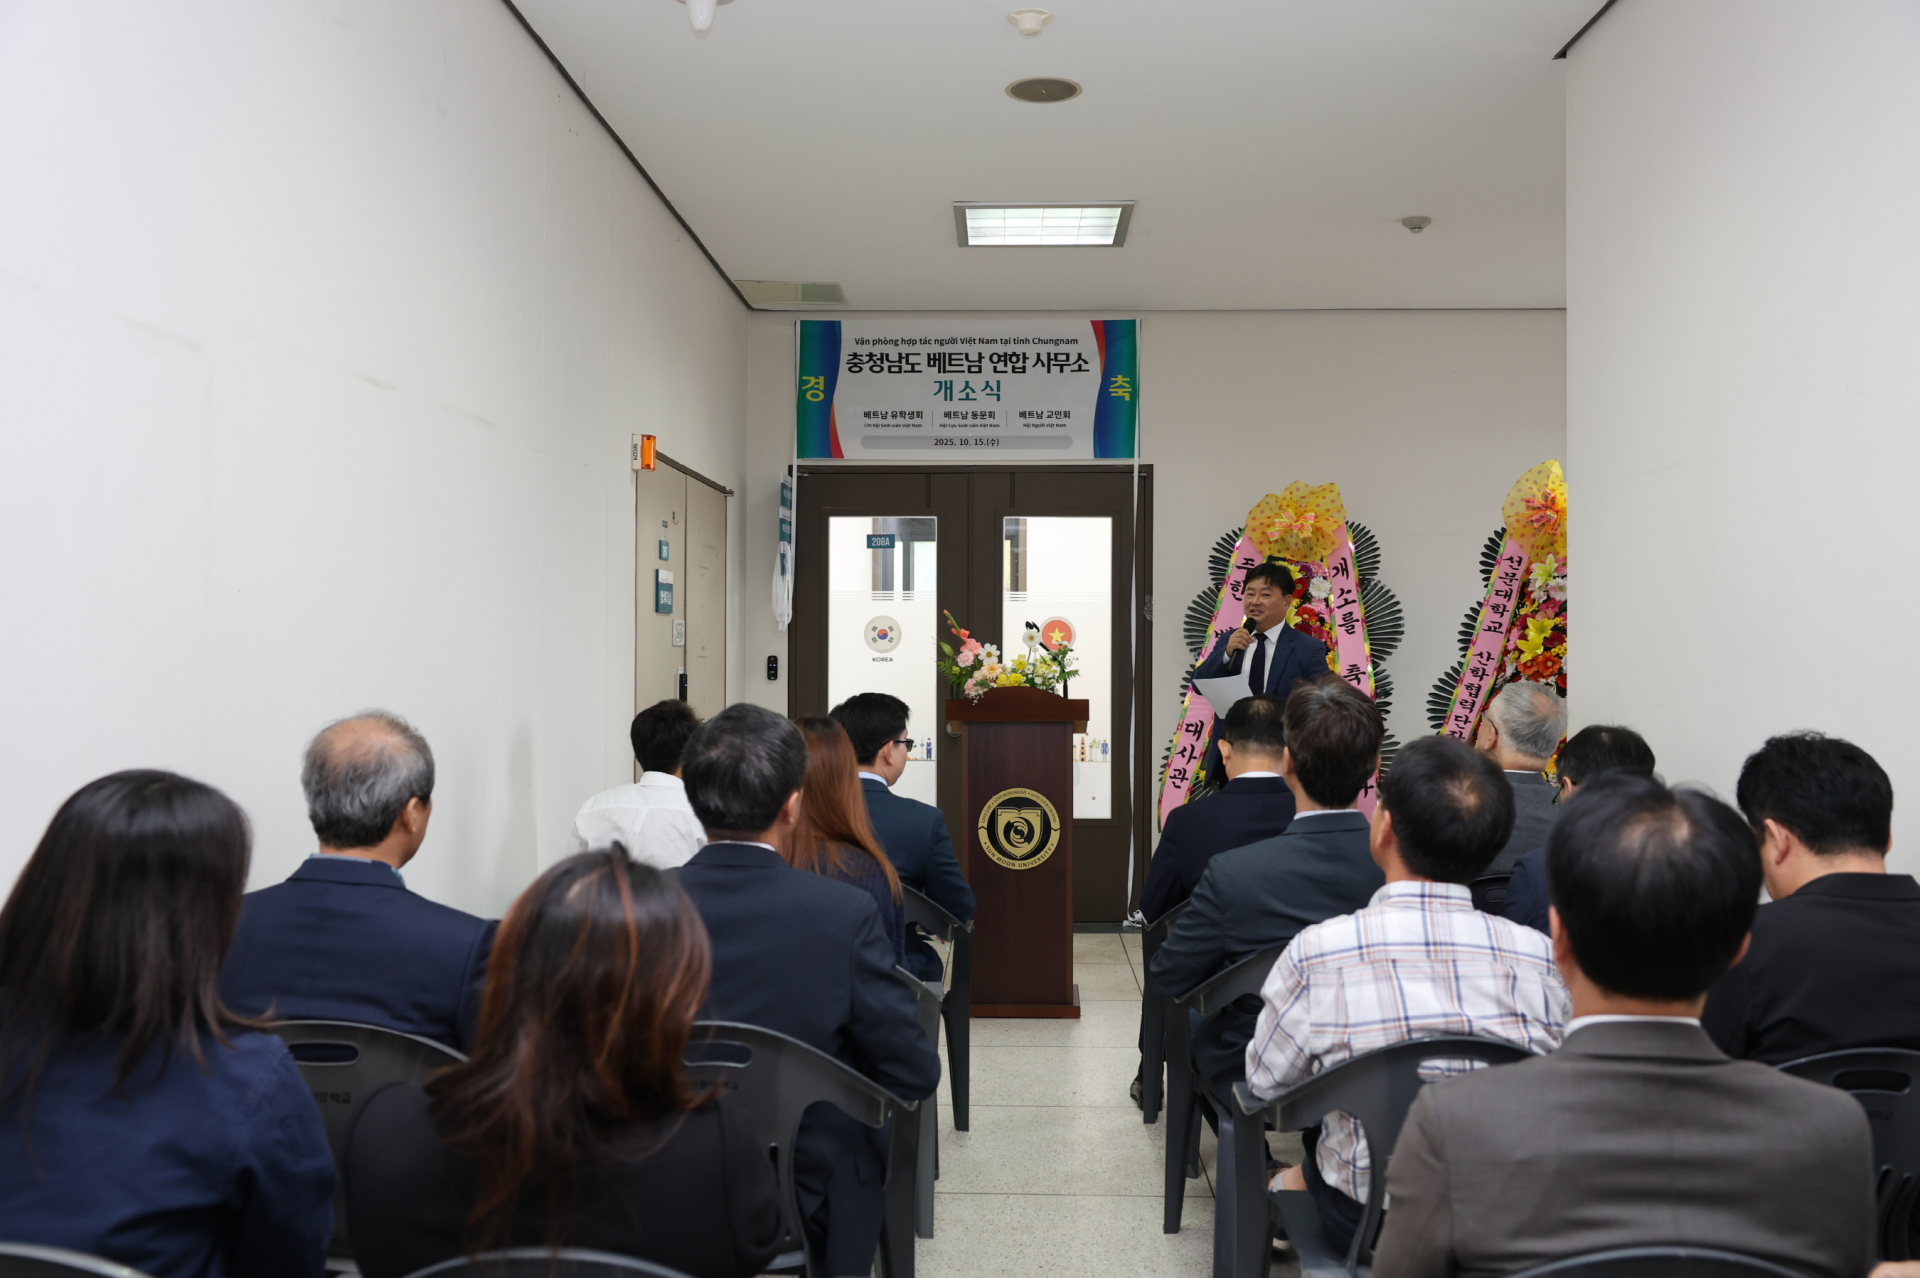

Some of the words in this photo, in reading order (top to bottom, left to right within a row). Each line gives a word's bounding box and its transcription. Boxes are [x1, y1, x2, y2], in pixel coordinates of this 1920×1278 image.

[854, 338, 870, 346] Văn
[872, 336, 900, 347] phòng
[901, 338, 918, 347] hợp
[919, 336, 932, 345] tác
[934, 336, 958, 346] người
[960, 336, 976, 346] Việt
[1000, 336, 1011, 346] tại
[1013, 336, 1030, 345] tỉnh
[1032, 337, 1078, 346] Chungnam
[846, 352, 922, 374] 충청남도
[926, 352, 985, 374] 베트남
[989, 352, 1029, 374] 연합
[1032, 352, 1090, 374] 사무소
[802, 376, 825, 401] 경
[1109, 374, 1132, 401] 축
[864, 410, 888, 420] 베트남
[890, 410, 923, 420] 유학생회
[944, 410, 968, 420] 베트남
[971, 410, 995, 420] 동문회
[1019, 410, 1044, 420] 베트남
[1046, 410, 1071, 420] 교민회
[872, 537, 890, 546] 208A
[1332, 557, 1360, 635] 개소를
[1482, 556, 1523, 634] 선문대학교
[1169, 720, 1204, 789] 대사관
[985, 845, 996, 857] SUN
[996, 857, 1015, 867] MOON
[1019, 847, 1052, 867] UNIVERSITY
